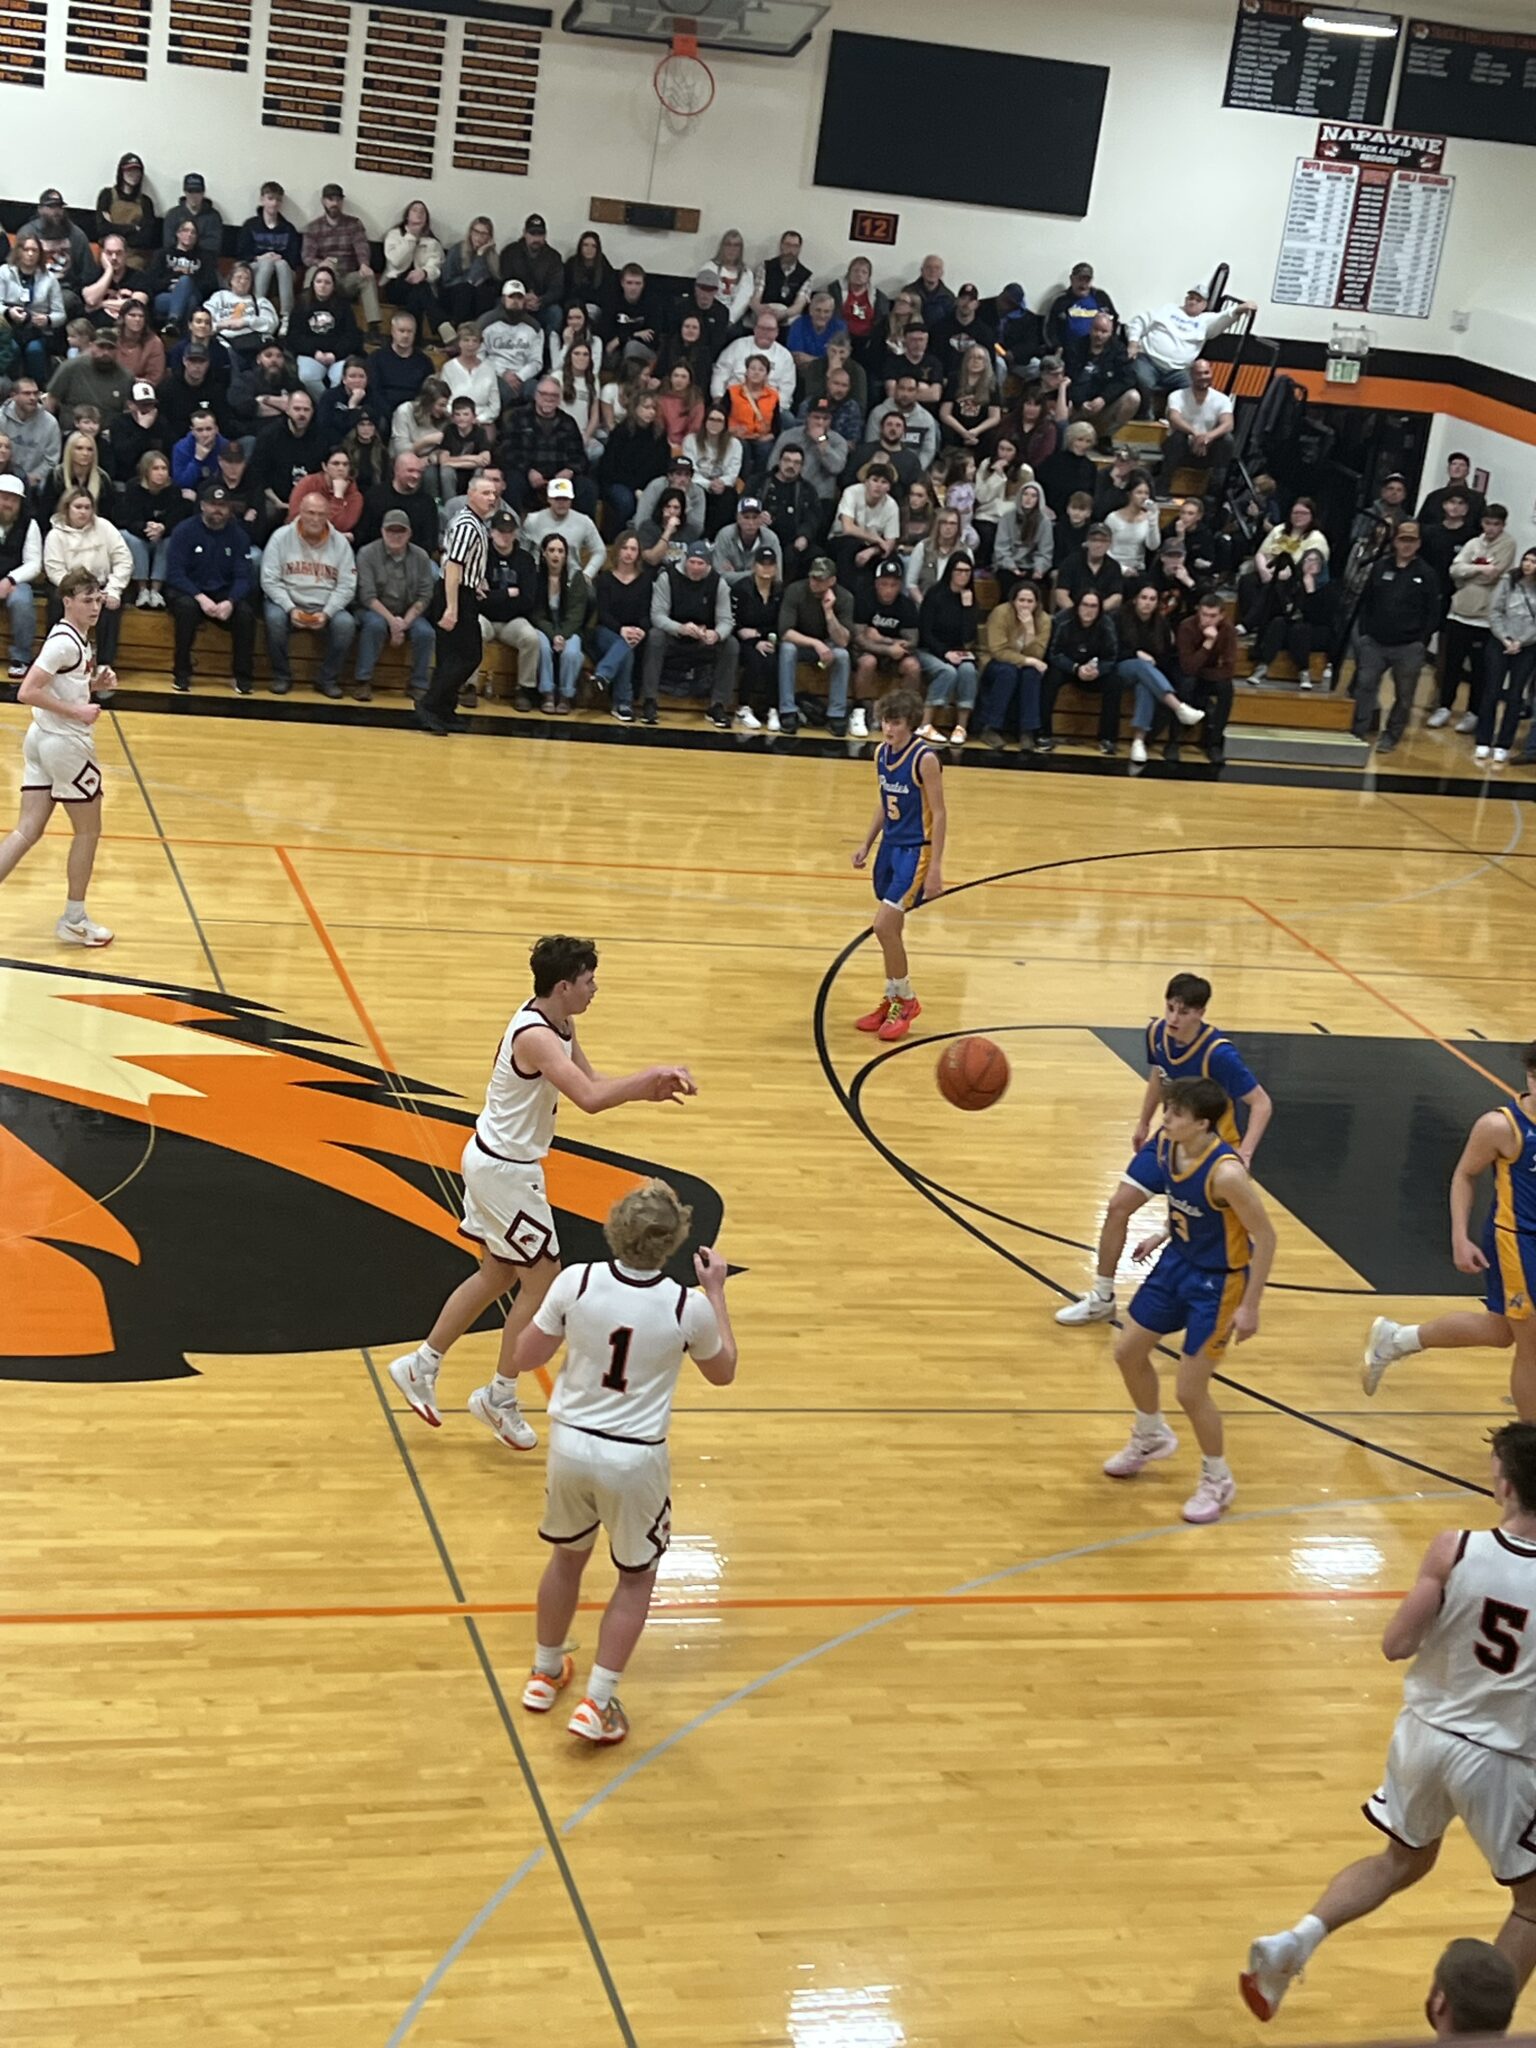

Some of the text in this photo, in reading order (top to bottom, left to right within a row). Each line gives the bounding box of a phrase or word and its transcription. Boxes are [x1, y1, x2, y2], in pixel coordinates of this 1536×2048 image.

[1320, 125, 1443, 155] NAPAVINE
[1350, 143, 1378, 154] TRACK
[1387, 147, 1412, 157] FIELD
[862, 219, 888, 237] 12
[886, 795, 901, 820] 5
[600, 1326, 634, 1394] 1
[1473, 1595, 1530, 1676] 5
